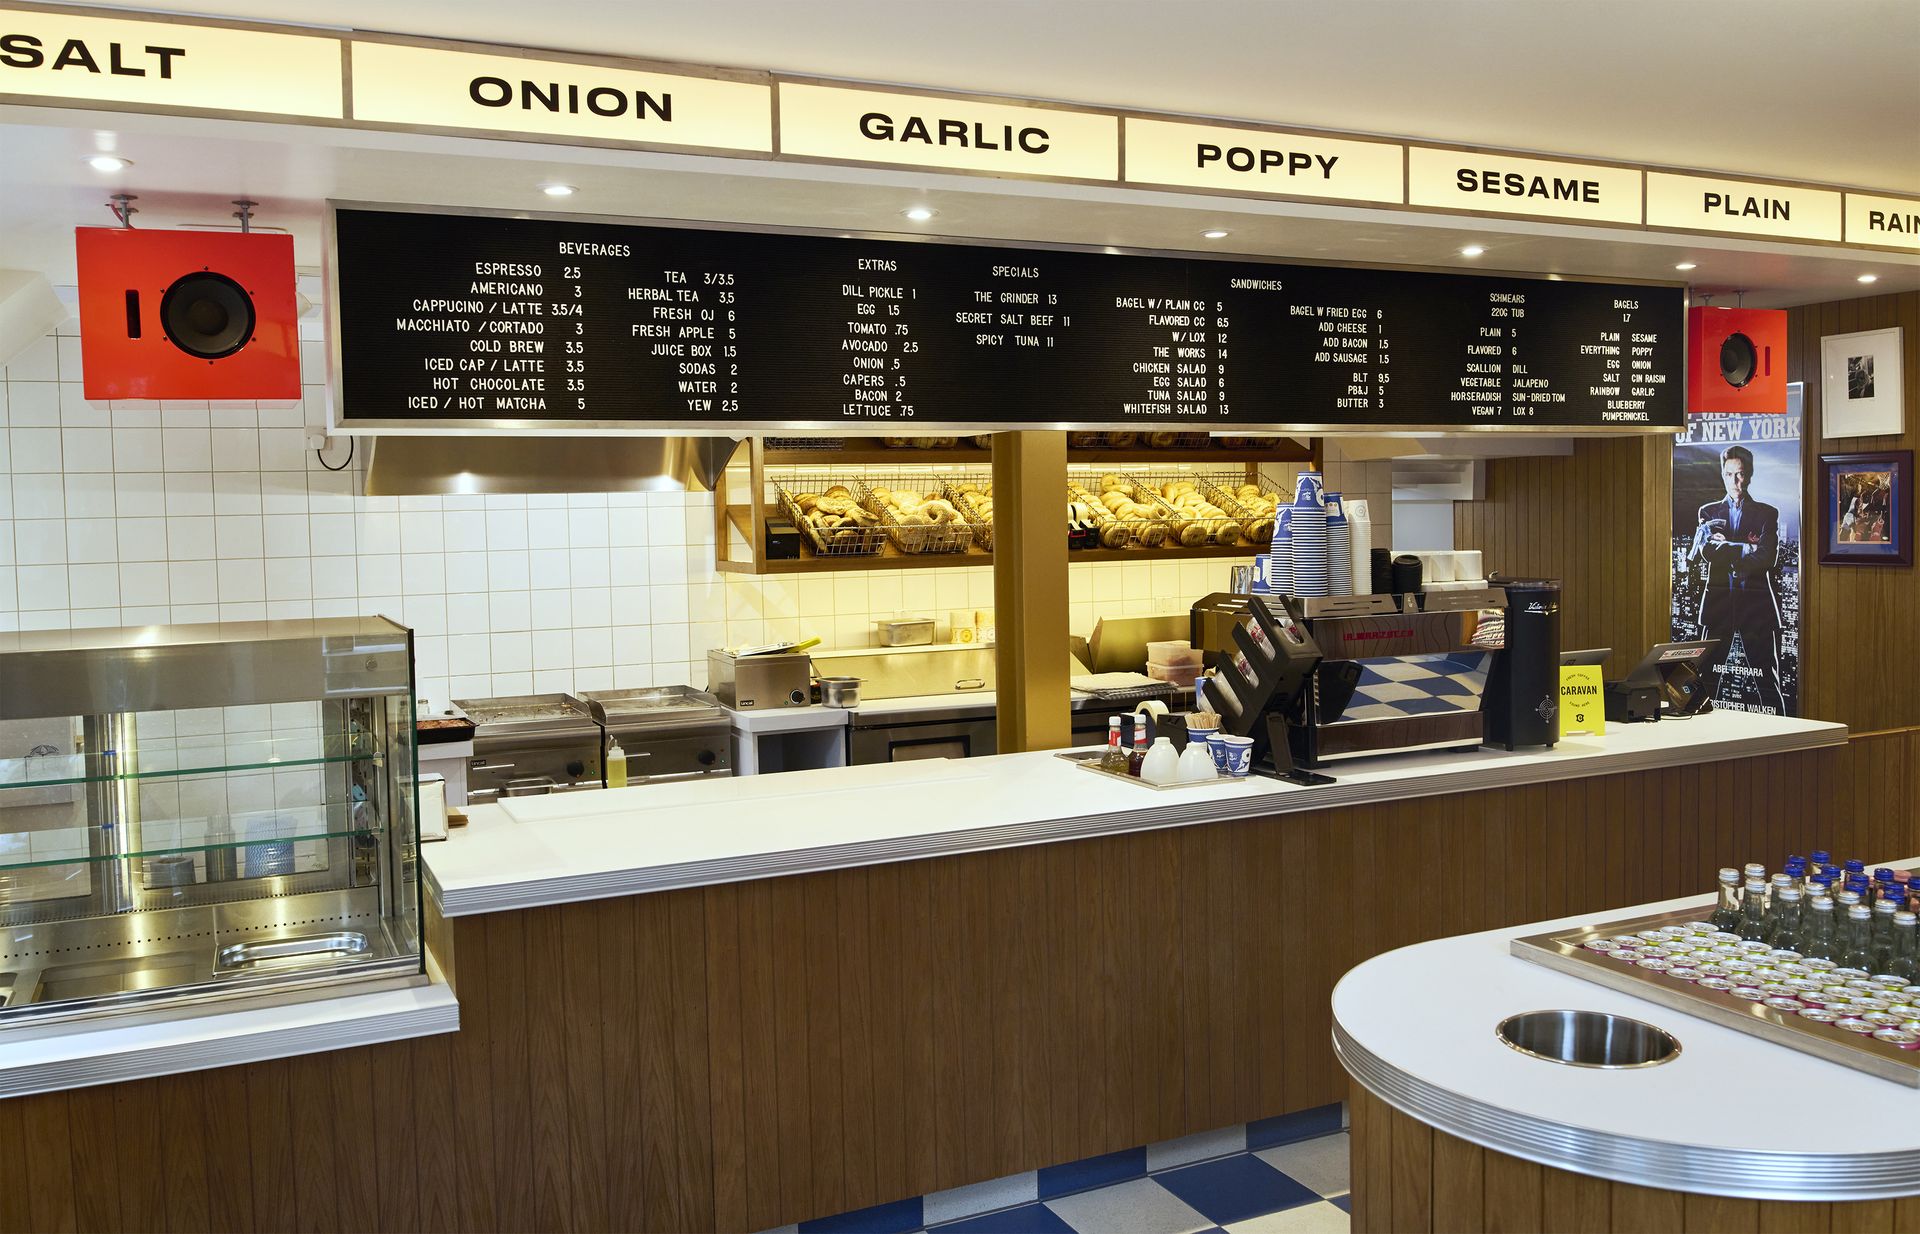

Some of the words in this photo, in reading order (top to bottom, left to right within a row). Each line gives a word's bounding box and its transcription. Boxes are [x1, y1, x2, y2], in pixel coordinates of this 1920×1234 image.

[0, 34, 186, 80] SALT
[469, 76, 672, 122] ONION
[859, 112, 1050, 154] GARLIC
[1197, 143, 1339, 180] POPPY
[1456, 168, 1600, 204] SESAME
[1704, 192, 1790, 221] PLAIN
[559, 242, 630, 257] BEVERAGES
[475, 262, 542, 277] ESPRESSO
[564, 266, 581, 279] 2.5
[858, 258, 897, 271] EXTRAS
[664, 271, 687, 284] TEA
[704, 273, 734, 285] 3/3.5
[992, 266, 1039, 278] SPECIALS
[470, 281, 543, 296] AMERICANO
[1231, 278, 1282, 291] SANDWICHES
[628, 288, 673, 301] HERBAL
[676, 290, 699, 302] TEA
[719, 292, 735, 304] 3.5
[842, 284, 864, 297] DILL
[869, 286, 903, 299] PICKLE
[974, 291, 992, 302] THE
[1000, 292, 1039, 304] GRINDER
[1048, 294, 1057, 305] 13
[1116, 297, 1145, 309] BAGEL
[1165, 299, 1190, 310] PLAIN
[1193, 301, 1205, 311] CC
[1490, 293, 1525, 303] SCHMEARS
[1614, 299, 1639, 309] BAGELS
[413, 299, 484, 313] CAPPUCINO
[503, 302, 543, 315] LATTE
[551, 303, 583, 316] 3.5/4
[857, 303, 875, 315] EGG
[1290, 305, 1315, 316] BAGEL
[1317, 307, 1324, 316] W
[1326, 307, 1349, 318] FRIED
[1352, 308, 1367, 319] EGG
[1491, 307, 1508, 317] 220G
[1511, 308, 1524, 318] TUB
[653, 307, 692, 320] FRESH
[701, 309, 714, 321] OJ
[956, 312, 993, 324] SECRET
[1000, 314, 1024, 325] SALT
[1030, 315, 1054, 326] BEEF
[1063, 316, 1070, 327] 11
[397, 318, 470, 332] MACCHIATO
[1149, 314, 1190, 326] FLAVORED
[1193, 316, 1205, 327] CC
[1217, 317, 1229, 328] 6.5
[632, 324, 670, 337] FRESH
[679, 326, 714, 339] APPLE
[847, 322, 887, 335] TOMATO
[895, 324, 908, 335] .75
[1318, 322, 1334, 332] ADD
[1337, 323, 1367, 333] CHEESE
[1480, 327, 1501, 337] PLAIN
[976, 334, 1004, 345] SPICY
[1014, 335, 1039, 347] TUNA
[1047, 337, 1053, 347] 11
[1189, 332, 1205, 343] LOX
[1218, 333, 1227, 343] 12
[1323, 337, 1339, 347] ADD
[1342, 338, 1368, 348] BACON
[1600, 332, 1620, 342] PLAIN
[1631, 333, 1657, 343] SESAME
[470, 339, 501, 352] COLD
[509, 340, 544, 353] BREW
[565, 341, 584, 354] 3.5
[651, 344, 684, 356] JUICE
[691, 345, 712, 357] BOX
[842, 339, 888, 352] AVOCADO
[903, 341, 919, 353] 2.5
[1467, 345, 1502, 355] FLAVORED
[1580, 345, 1620, 355] EVERYTHING
[1631, 347, 1653, 356] POPPY
[1153, 346, 1170, 357] THE
[1177, 347, 1206, 358] WORKS
[1218, 349, 1228, 359] 14
[1314, 352, 1330, 362] ADD
[1333, 353, 1367, 363] SAUSAGE
[425, 358, 454, 371] ICED
[459, 358, 485, 371] CAP
[504, 359, 545, 372] LATTE
[566, 360, 584, 372] 3.5
[679, 362, 716, 375] SODAS
[853, 356, 884, 369] ONION
[891, 358, 900, 370] .5
[1133, 362, 1170, 374] CHICKEN
[1176, 363, 1206, 374] SALAD
[1466, 363, 1501, 373] SCALLION
[1512, 364, 1528, 374] DILL
[1607, 359, 1620, 369] EGG
[1631, 360, 1651, 370] ONION
[433, 377, 459, 390] HOT
[470, 378, 545, 391] CHOCOLATE
[567, 379, 585, 391] 3.5
[843, 374, 884, 387] CAPERS
[895, 376, 906, 387] .5
[1153, 376, 1170, 387] EGG
[1177, 377, 1207, 388] SALAD
[1353, 372, 1368, 382] BLT
[1378, 373, 1390, 384] 9.5
[1460, 377, 1501, 387] VEGETABLE
[1512, 379, 1549, 388] JALAPENO
[1602, 373, 1620, 383] SALT
[1631, 374, 1643, 383] CIN
[1645, 374, 1666, 383] RAISIN
[678, 381, 717, 393] WATER
[1348, 385, 1368, 395] PB&J
[1590, 386, 1620, 396] RAINBOW
[1631, 387, 1655, 396] GARLIC
[855, 389, 887, 401] BACON
[1147, 390, 1171, 401] TUNA
[1176, 390, 1207, 401] SALAD
[1451, 391, 1501, 401] HORSERADISH
[1551, 393, 1565, 402] TOM
[408, 396, 438, 409] ICED
[459, 397, 485, 409] HOT
[496, 397, 546, 410] MATCHA
[687, 399, 712, 411] YEW
[722, 400, 738, 412] 2.5
[1123, 403, 1171, 414] WHITEFISH
[1177, 404, 1207, 414] SALAD
[1219, 404, 1229, 415] 13
[1337, 398, 1368, 408] BUTTER
[1607, 400, 1646, 410] BLUEBERRY
[843, 403, 891, 416] LETTUCE
[900, 405, 914, 416] .75
[1471, 406, 1494, 415] VEGAN
[1513, 406, 1526, 416] LOX
[1529, 407, 1534, 416] 8
[1602, 411, 1650, 421] PUMPERNICKEL
[1702, 420, 1744, 442] NEW
[1749, 416, 1800, 440] YORK
[1712, 664, 1729, 674] ABEL
[1731, 666, 1763, 677] FERRARA
[1561, 685, 1597, 696] CARAVAN
[1746, 703, 1776, 715] WALKEN
